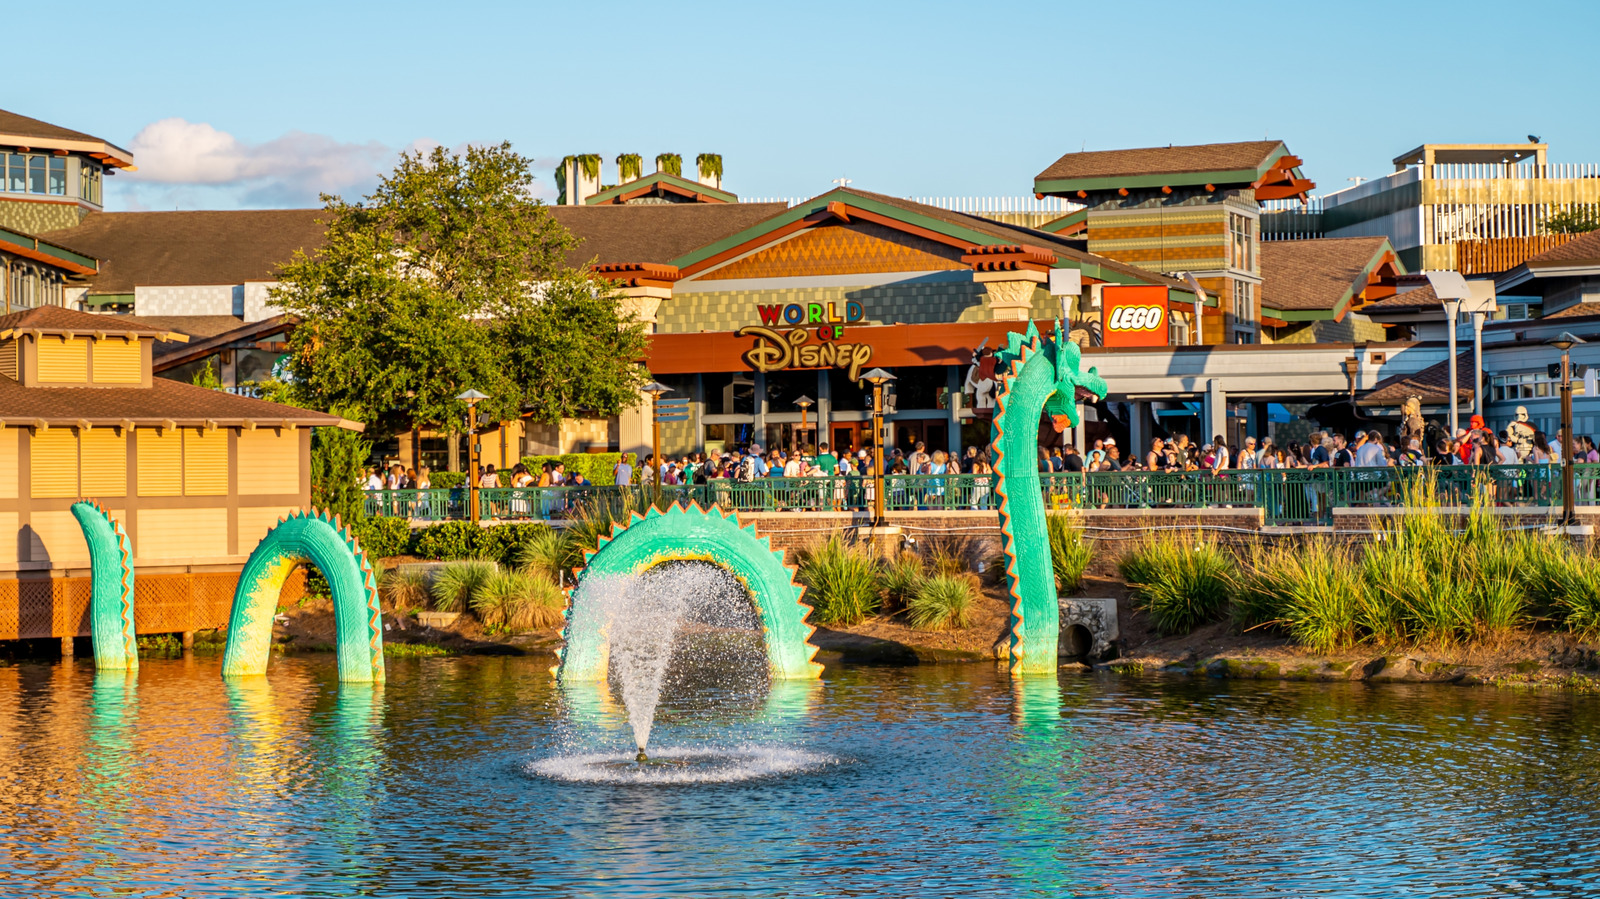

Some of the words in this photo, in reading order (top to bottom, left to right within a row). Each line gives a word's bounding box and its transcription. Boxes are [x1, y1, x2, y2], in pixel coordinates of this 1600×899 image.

[757, 302, 865, 326] WORLD
[1109, 306, 1162, 331] LEGO
[818, 325, 844, 340] OF
